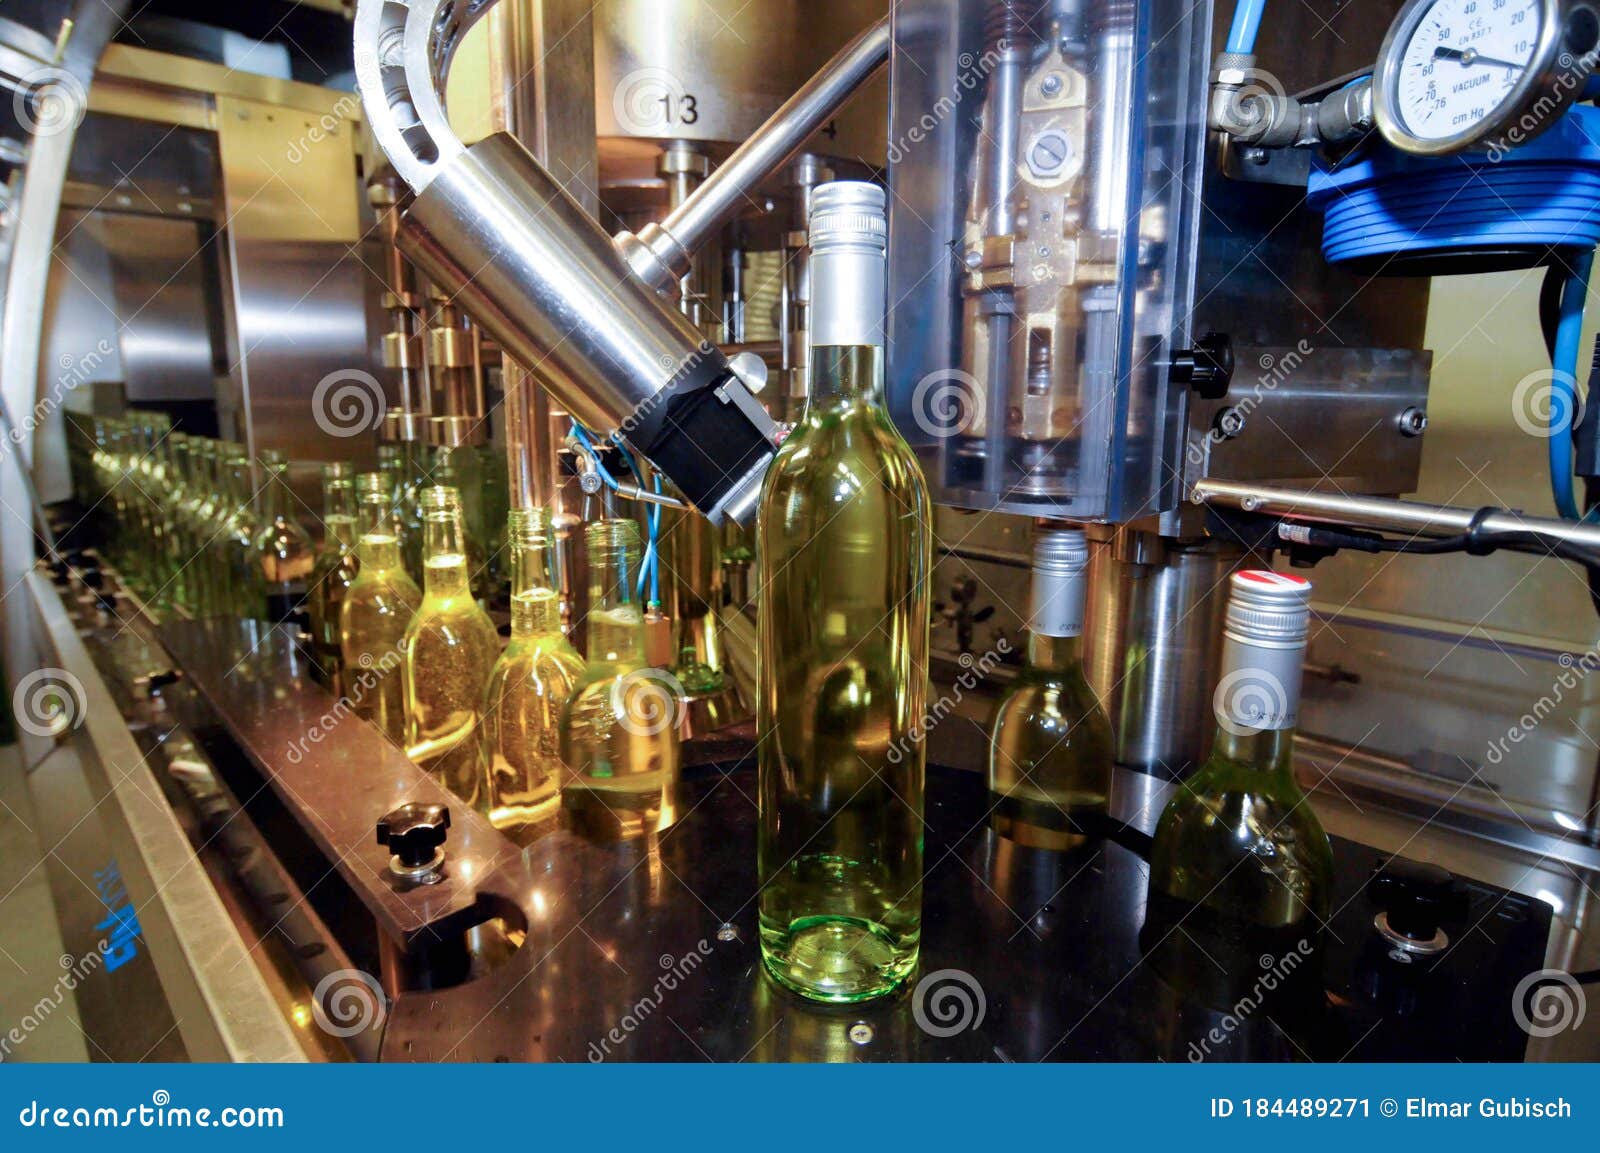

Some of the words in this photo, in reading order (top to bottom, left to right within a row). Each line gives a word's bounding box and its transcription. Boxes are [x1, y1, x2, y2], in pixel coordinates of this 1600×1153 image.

[1464, 1, 1476, 14] 40
[1493, 0, 1505, 10] 30
[1511, 11, 1525, 25] 20
[1439, 28, 1450, 40] 50
[1515, 40, 1527, 53] 10
[1422, 64, 1434, 77] 60
[1452, 73, 1491, 94] VACUUM
[1426, 89, 1436, 101] 70
[657, 94, 698, 125] 13
[1452, 113, 1467, 126] cm
[1471, 107, 1485, 120] Hg
